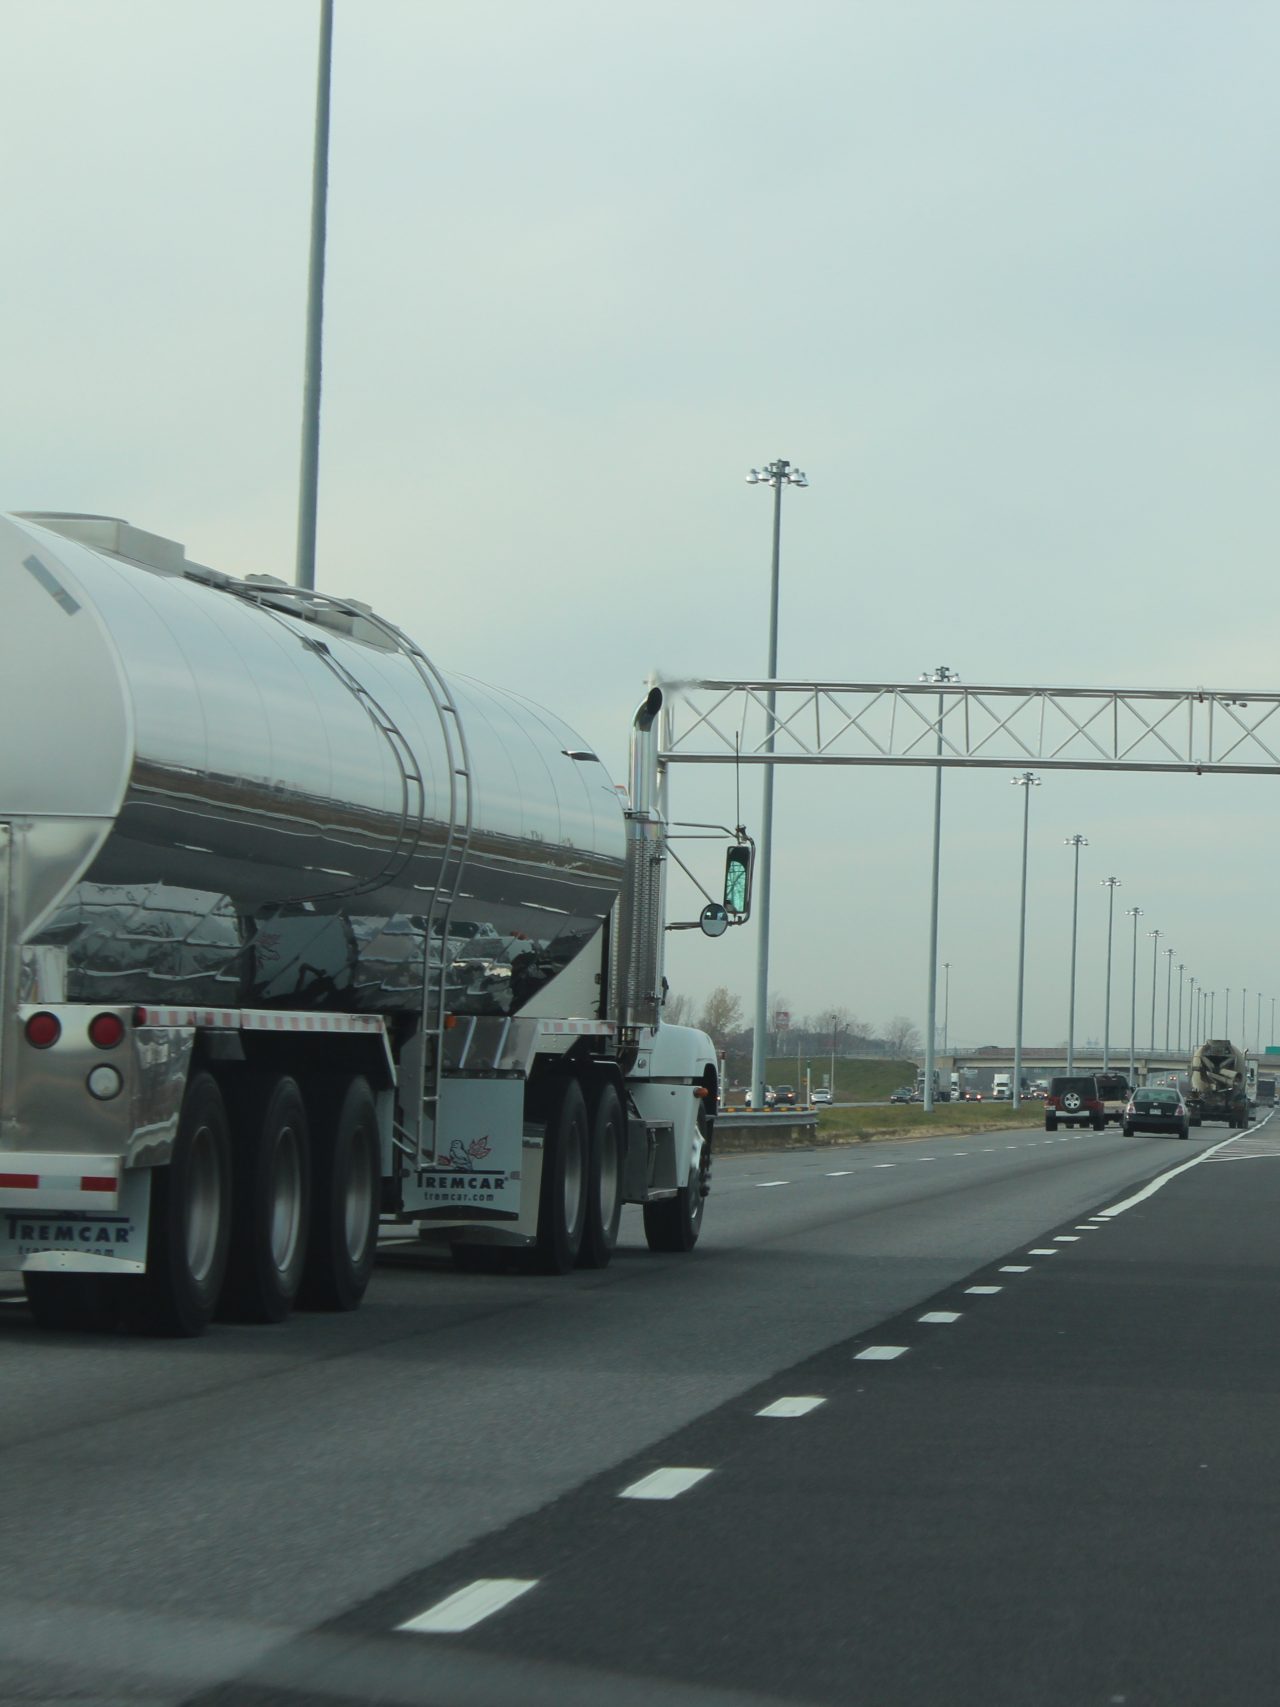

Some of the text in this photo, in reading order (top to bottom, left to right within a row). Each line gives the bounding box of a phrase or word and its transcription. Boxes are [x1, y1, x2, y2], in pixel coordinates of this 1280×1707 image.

[414, 1169, 505, 1189] TREMCAR
[424, 1191, 494, 1201] tremcar.com
[5, 1214, 130, 1243] TREMCAR
